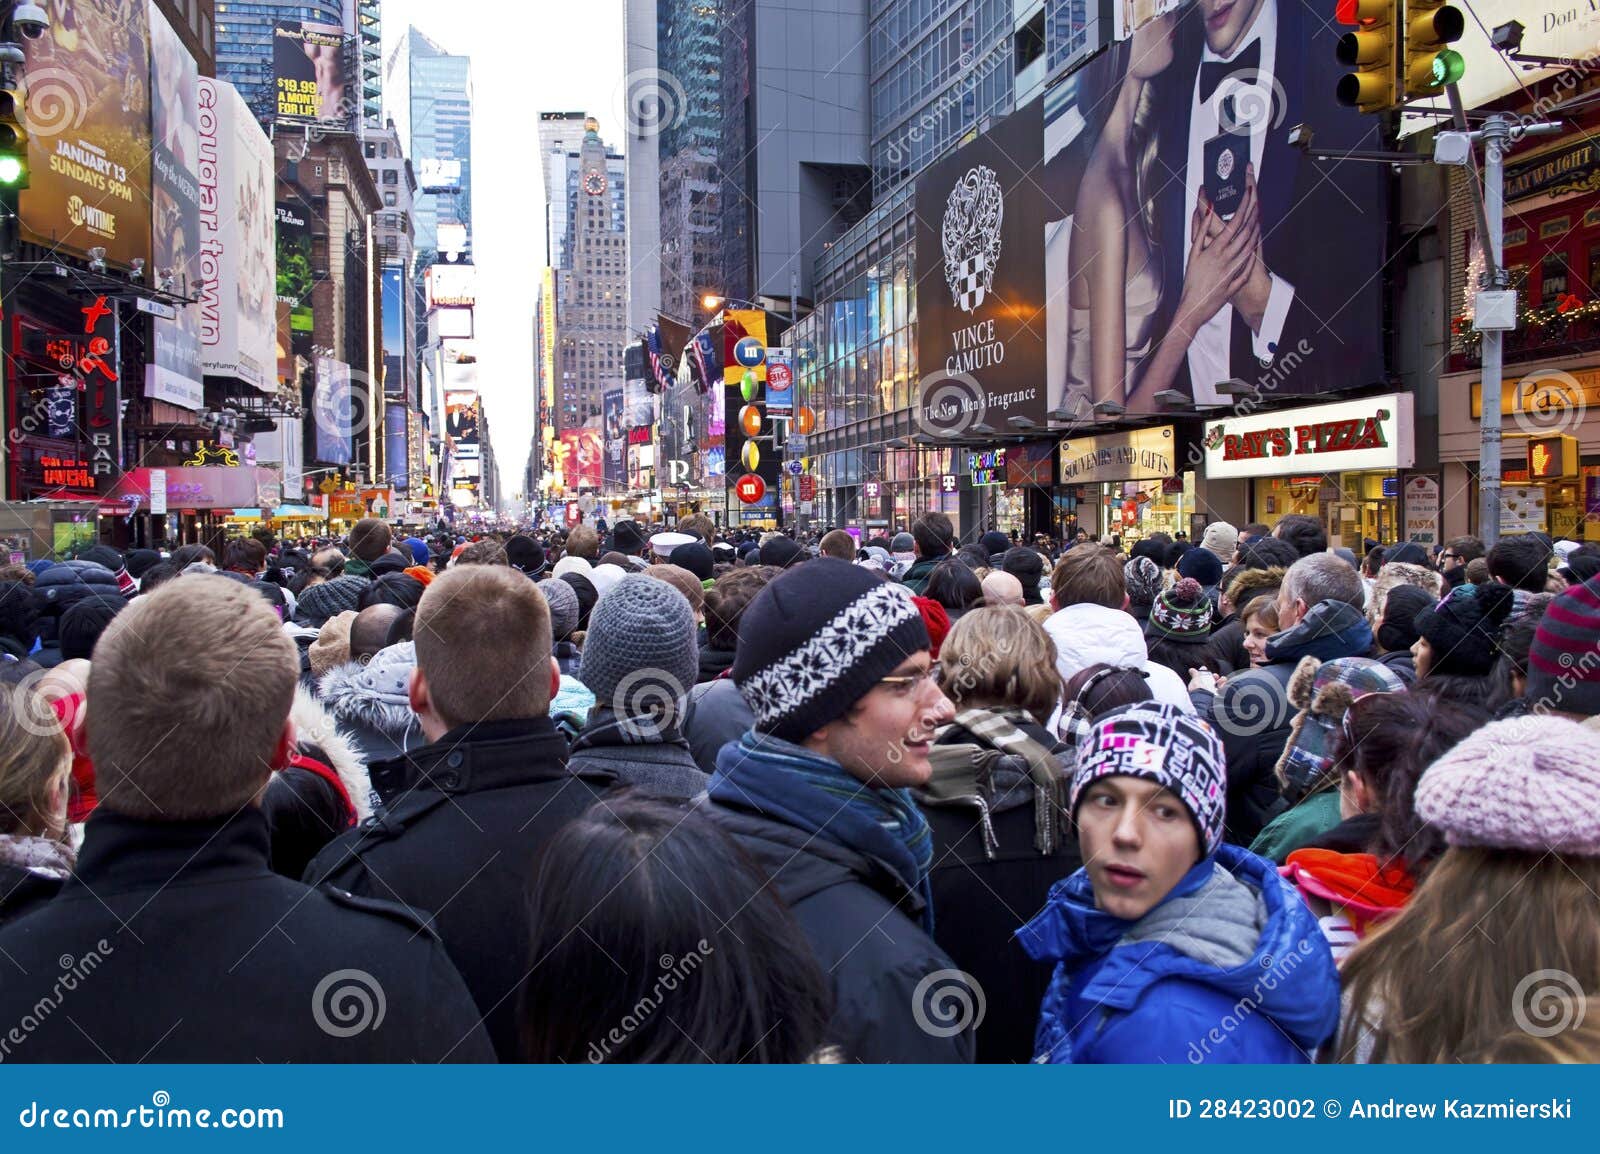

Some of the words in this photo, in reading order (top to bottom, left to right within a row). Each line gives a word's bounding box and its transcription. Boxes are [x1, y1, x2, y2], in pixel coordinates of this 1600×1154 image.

[1544, 8, 1577, 33] Don
[277, 77, 318, 95] $19.99
[278, 91, 286, 102] A
[287, 92, 323, 105] MONTH
[278, 102, 298, 114] FOR
[300, 104, 320, 116] LIFE
[56, 139, 112, 176] JANUARY
[113, 163, 127, 183] 13
[50, 154, 106, 191] SUNDAYS
[107, 179, 133, 203] 9PM
[281, 215, 305, 226] SOUND
[199, 239, 222, 346] town
[433, 296, 474, 305] TOSHIBA
[952, 319, 996, 351] VINCE
[744, 346, 758, 358] m
[946, 341, 1005, 377] CAMUTO
[924, 406, 939, 421] The
[940, 402, 958, 418] New
[960, 393, 985, 414] Men's
[988, 387, 1036, 411] Fragrance
[1513, 381, 1572, 411] Pax
[93, 432, 111, 475] BAR
[1223, 427, 1293, 461] RAY'S
[1294, 417, 1389, 455] PIZZA
[668, 460, 698, 489] R
[1064, 447, 1112, 481] SOUVENIRS
[1116, 447, 1137, 465] AND
[1141, 448, 1169, 476] GIFTS
[743, 483, 756, 495] m
[1408, 519, 1435, 529] PASTA
[1553, 511, 1576, 527] Pax
